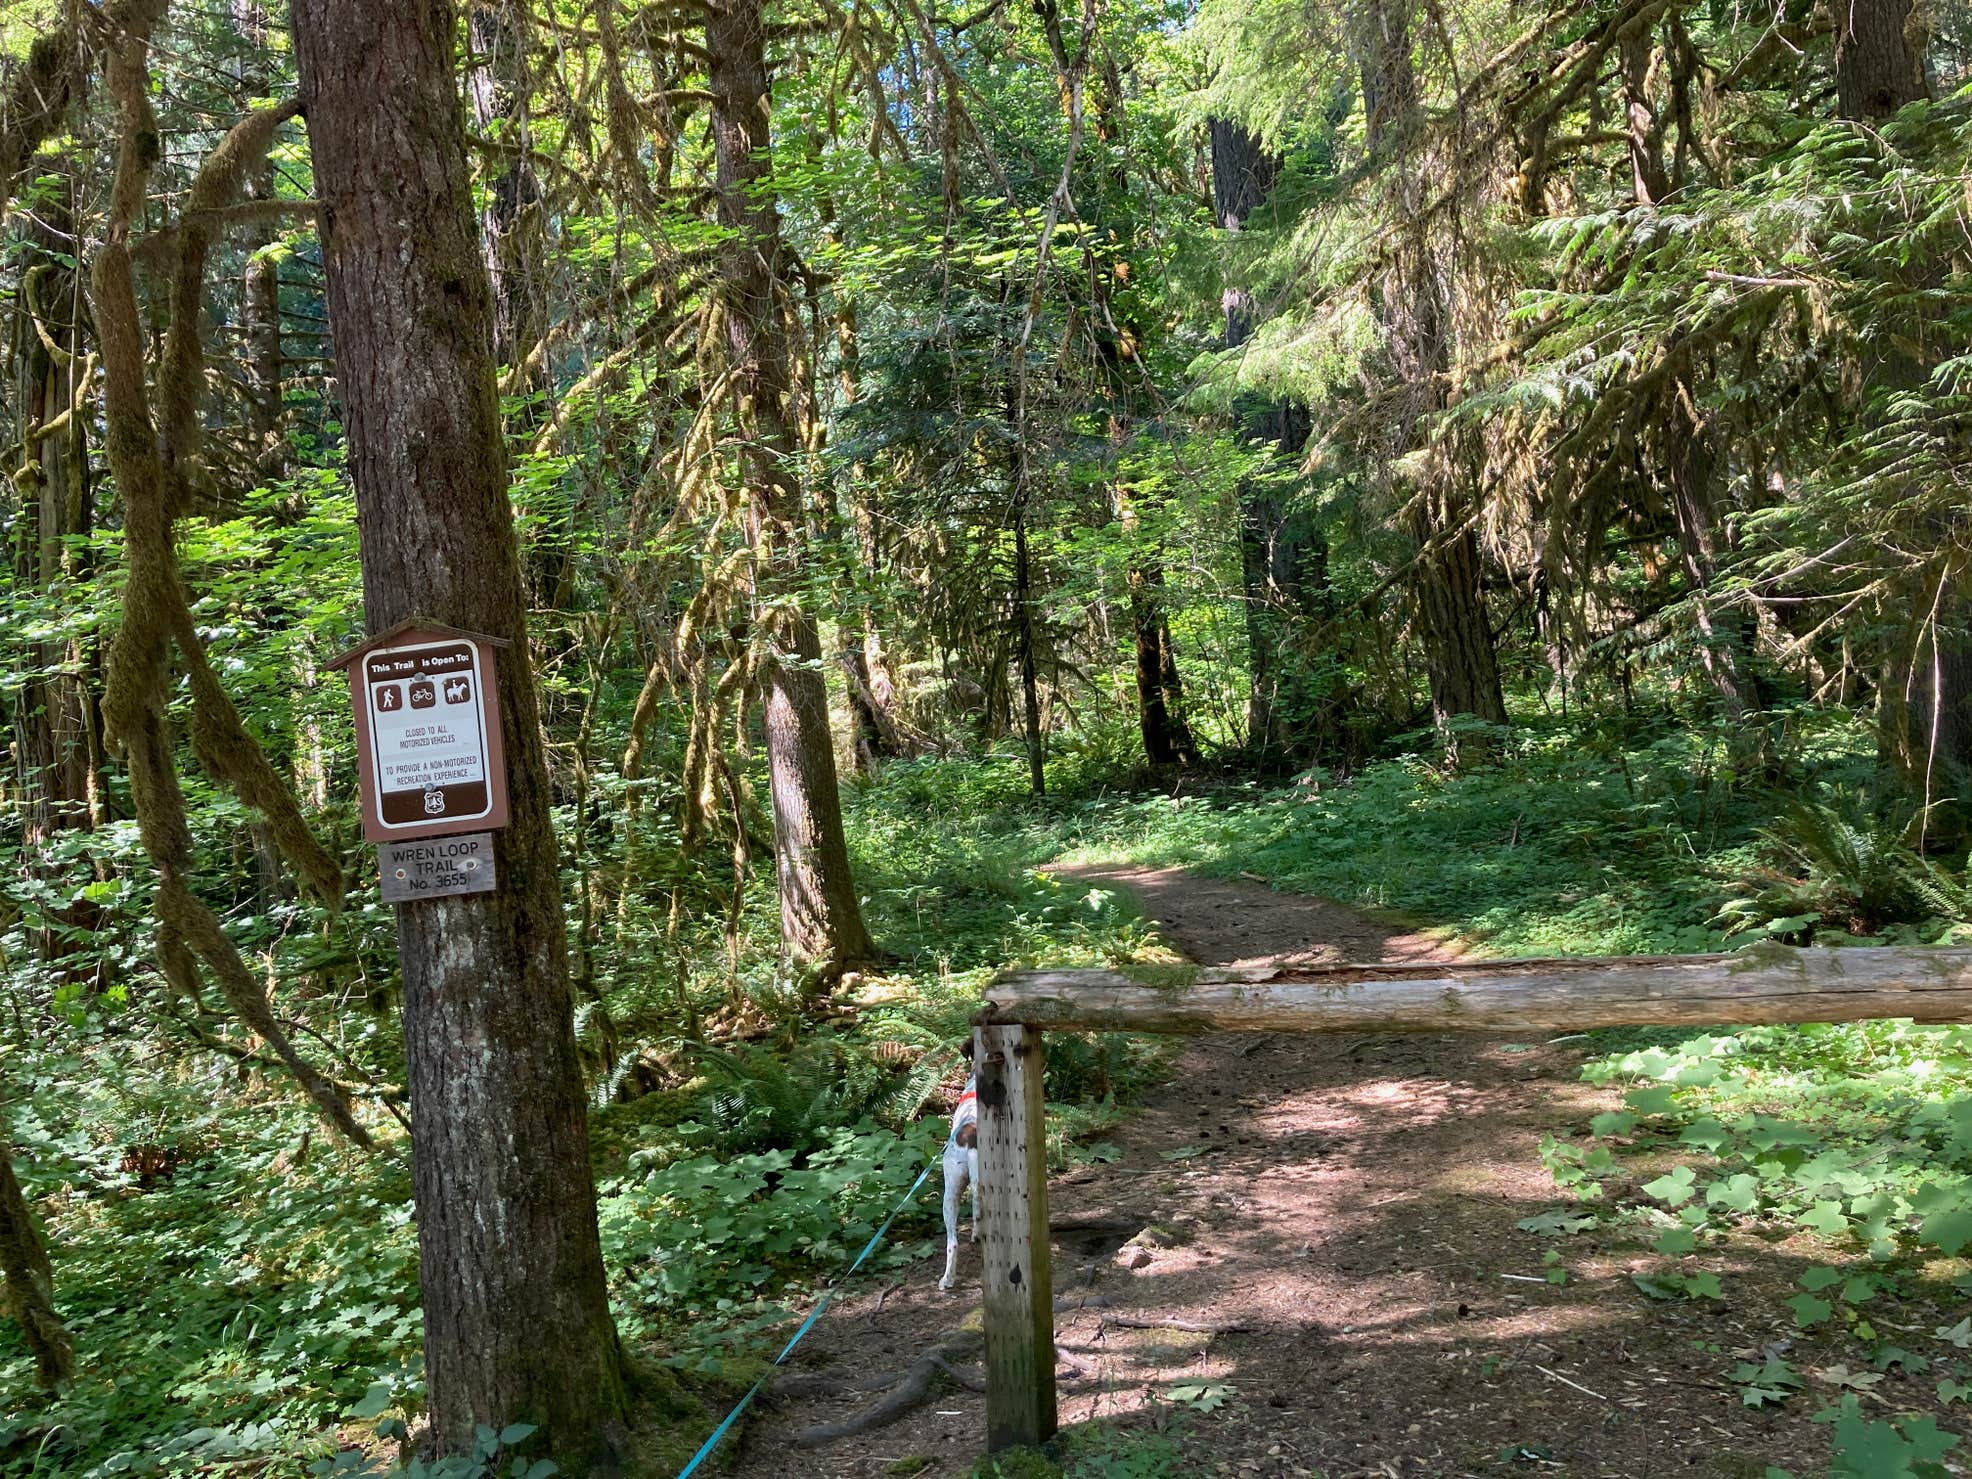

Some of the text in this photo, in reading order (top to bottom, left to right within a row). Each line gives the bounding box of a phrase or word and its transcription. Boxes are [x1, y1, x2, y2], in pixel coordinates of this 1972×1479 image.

[371, 664, 391, 673] This
[393, 660, 415, 670] Trail
[431, 656, 455, 666] Open
[456, 654, 469, 662] To:
[405, 724, 448, 738] CLOSED TO ALL
[400, 734, 456, 749] MOTORIZED VEHICLES
[386, 766, 394, 775] TO
[396, 763, 421, 774] PROVIDE
[430, 756, 477, 769] NON-MOTORIZED
[397, 769, 468, 785] RECREATION EXPERIENCE
[392, 842, 479, 862] WREN LOOP
[416, 861, 458, 875] TRAIL
[409, 873, 467, 891] No. 3655
